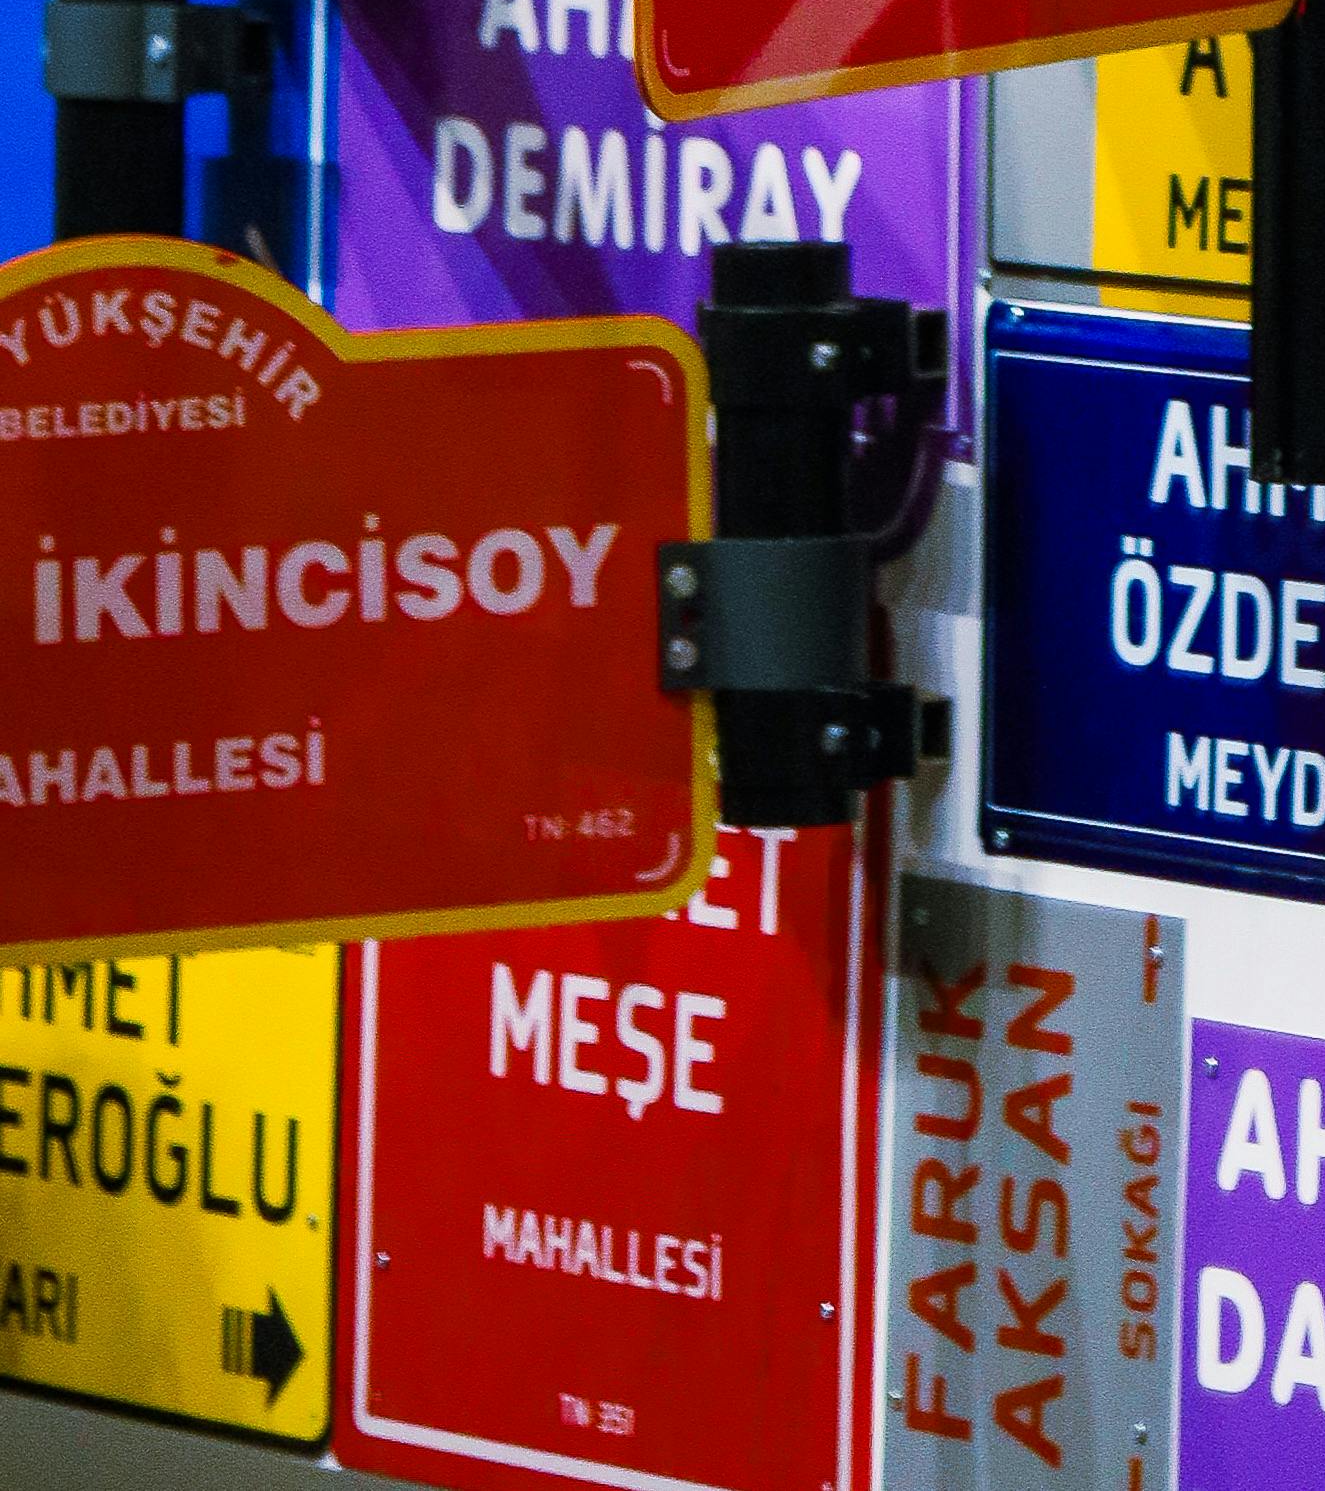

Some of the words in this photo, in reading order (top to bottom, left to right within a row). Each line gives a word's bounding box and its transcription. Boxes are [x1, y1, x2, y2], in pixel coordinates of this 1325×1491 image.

[431, 115, 864, 259] DEMİRAY
[33, 512, 620, 647] İKİNCİSOY
[489, 961, 728, 1121] MEŞE
[482, 1202, 724, 1303] MAHALLESİ
[902, 958, 989, 1443] FARUK
[992, 962, 1076, 1470] AKSAN
